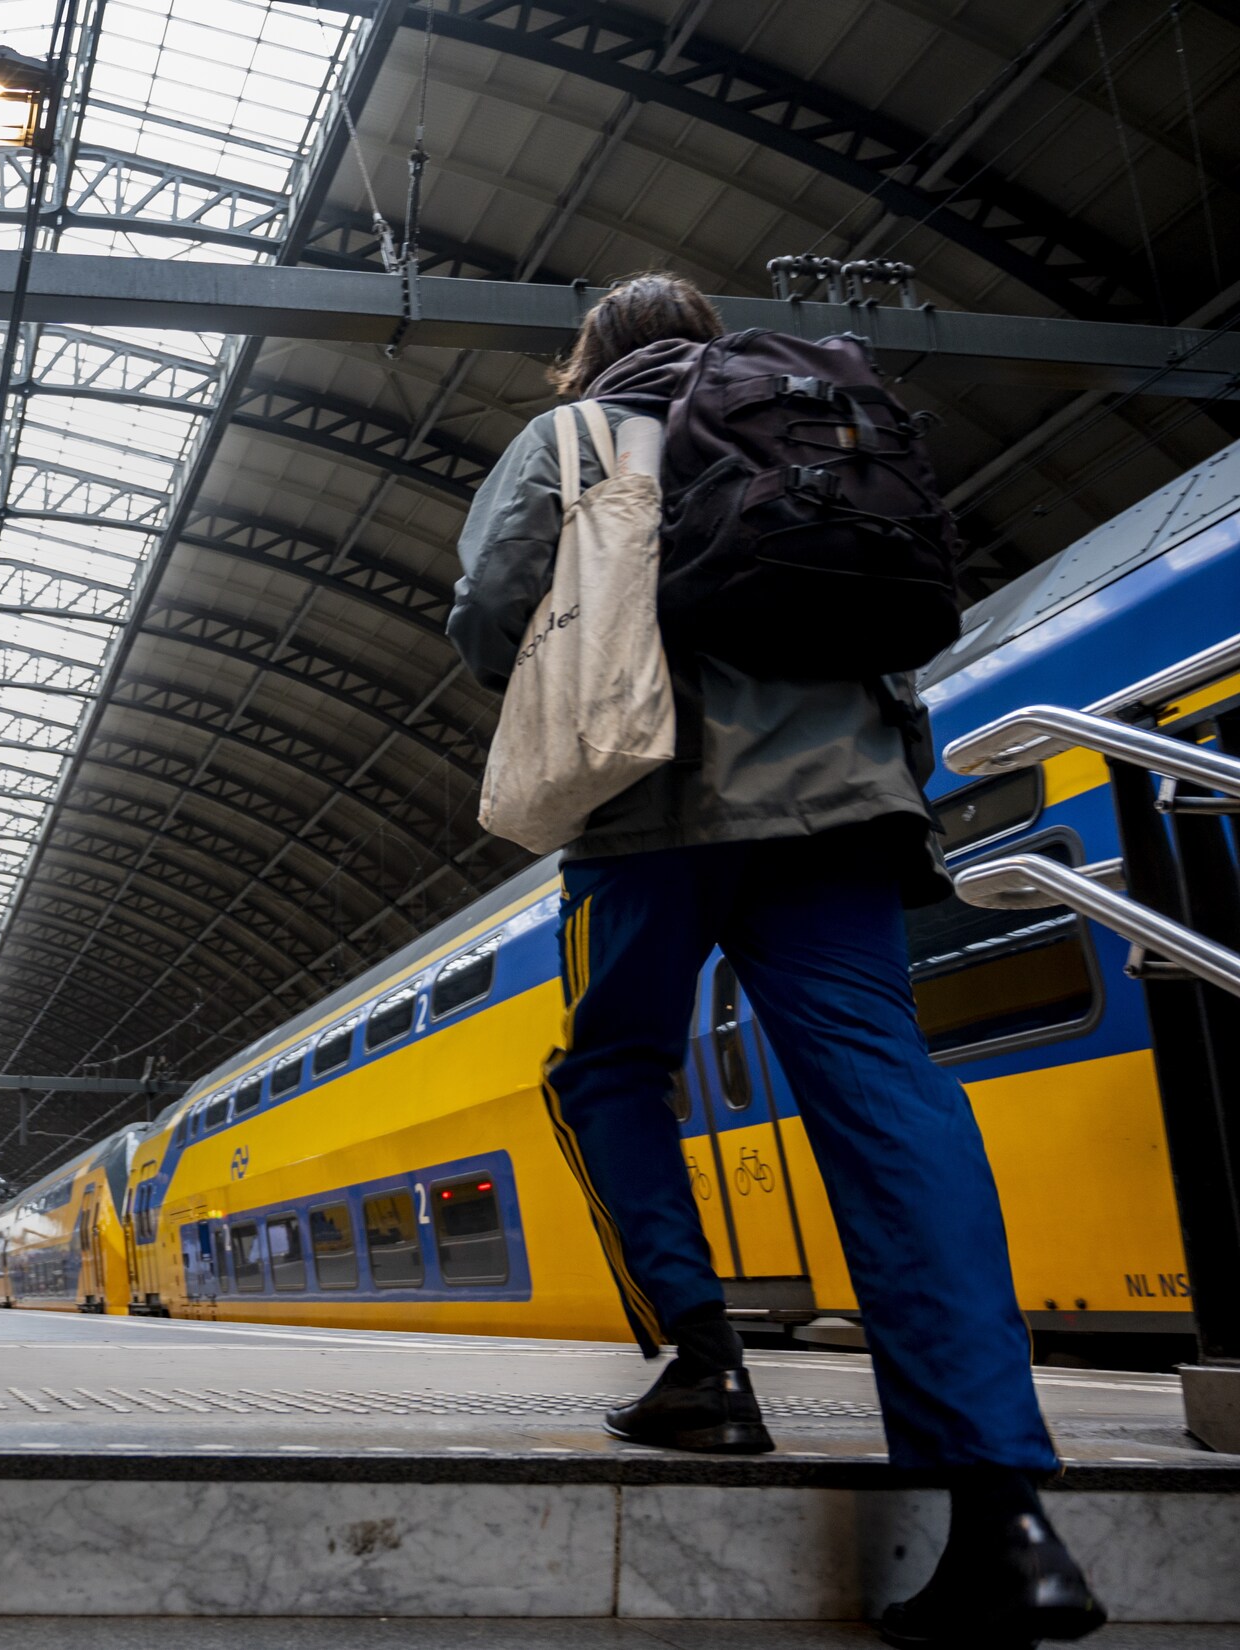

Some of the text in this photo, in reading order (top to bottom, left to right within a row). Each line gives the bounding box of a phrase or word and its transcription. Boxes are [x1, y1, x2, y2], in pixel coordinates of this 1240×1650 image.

[416, 994, 429, 1033] 2
[414, 1183, 430, 1225] 2
[1124, 1272, 1192, 1297] NL NS
